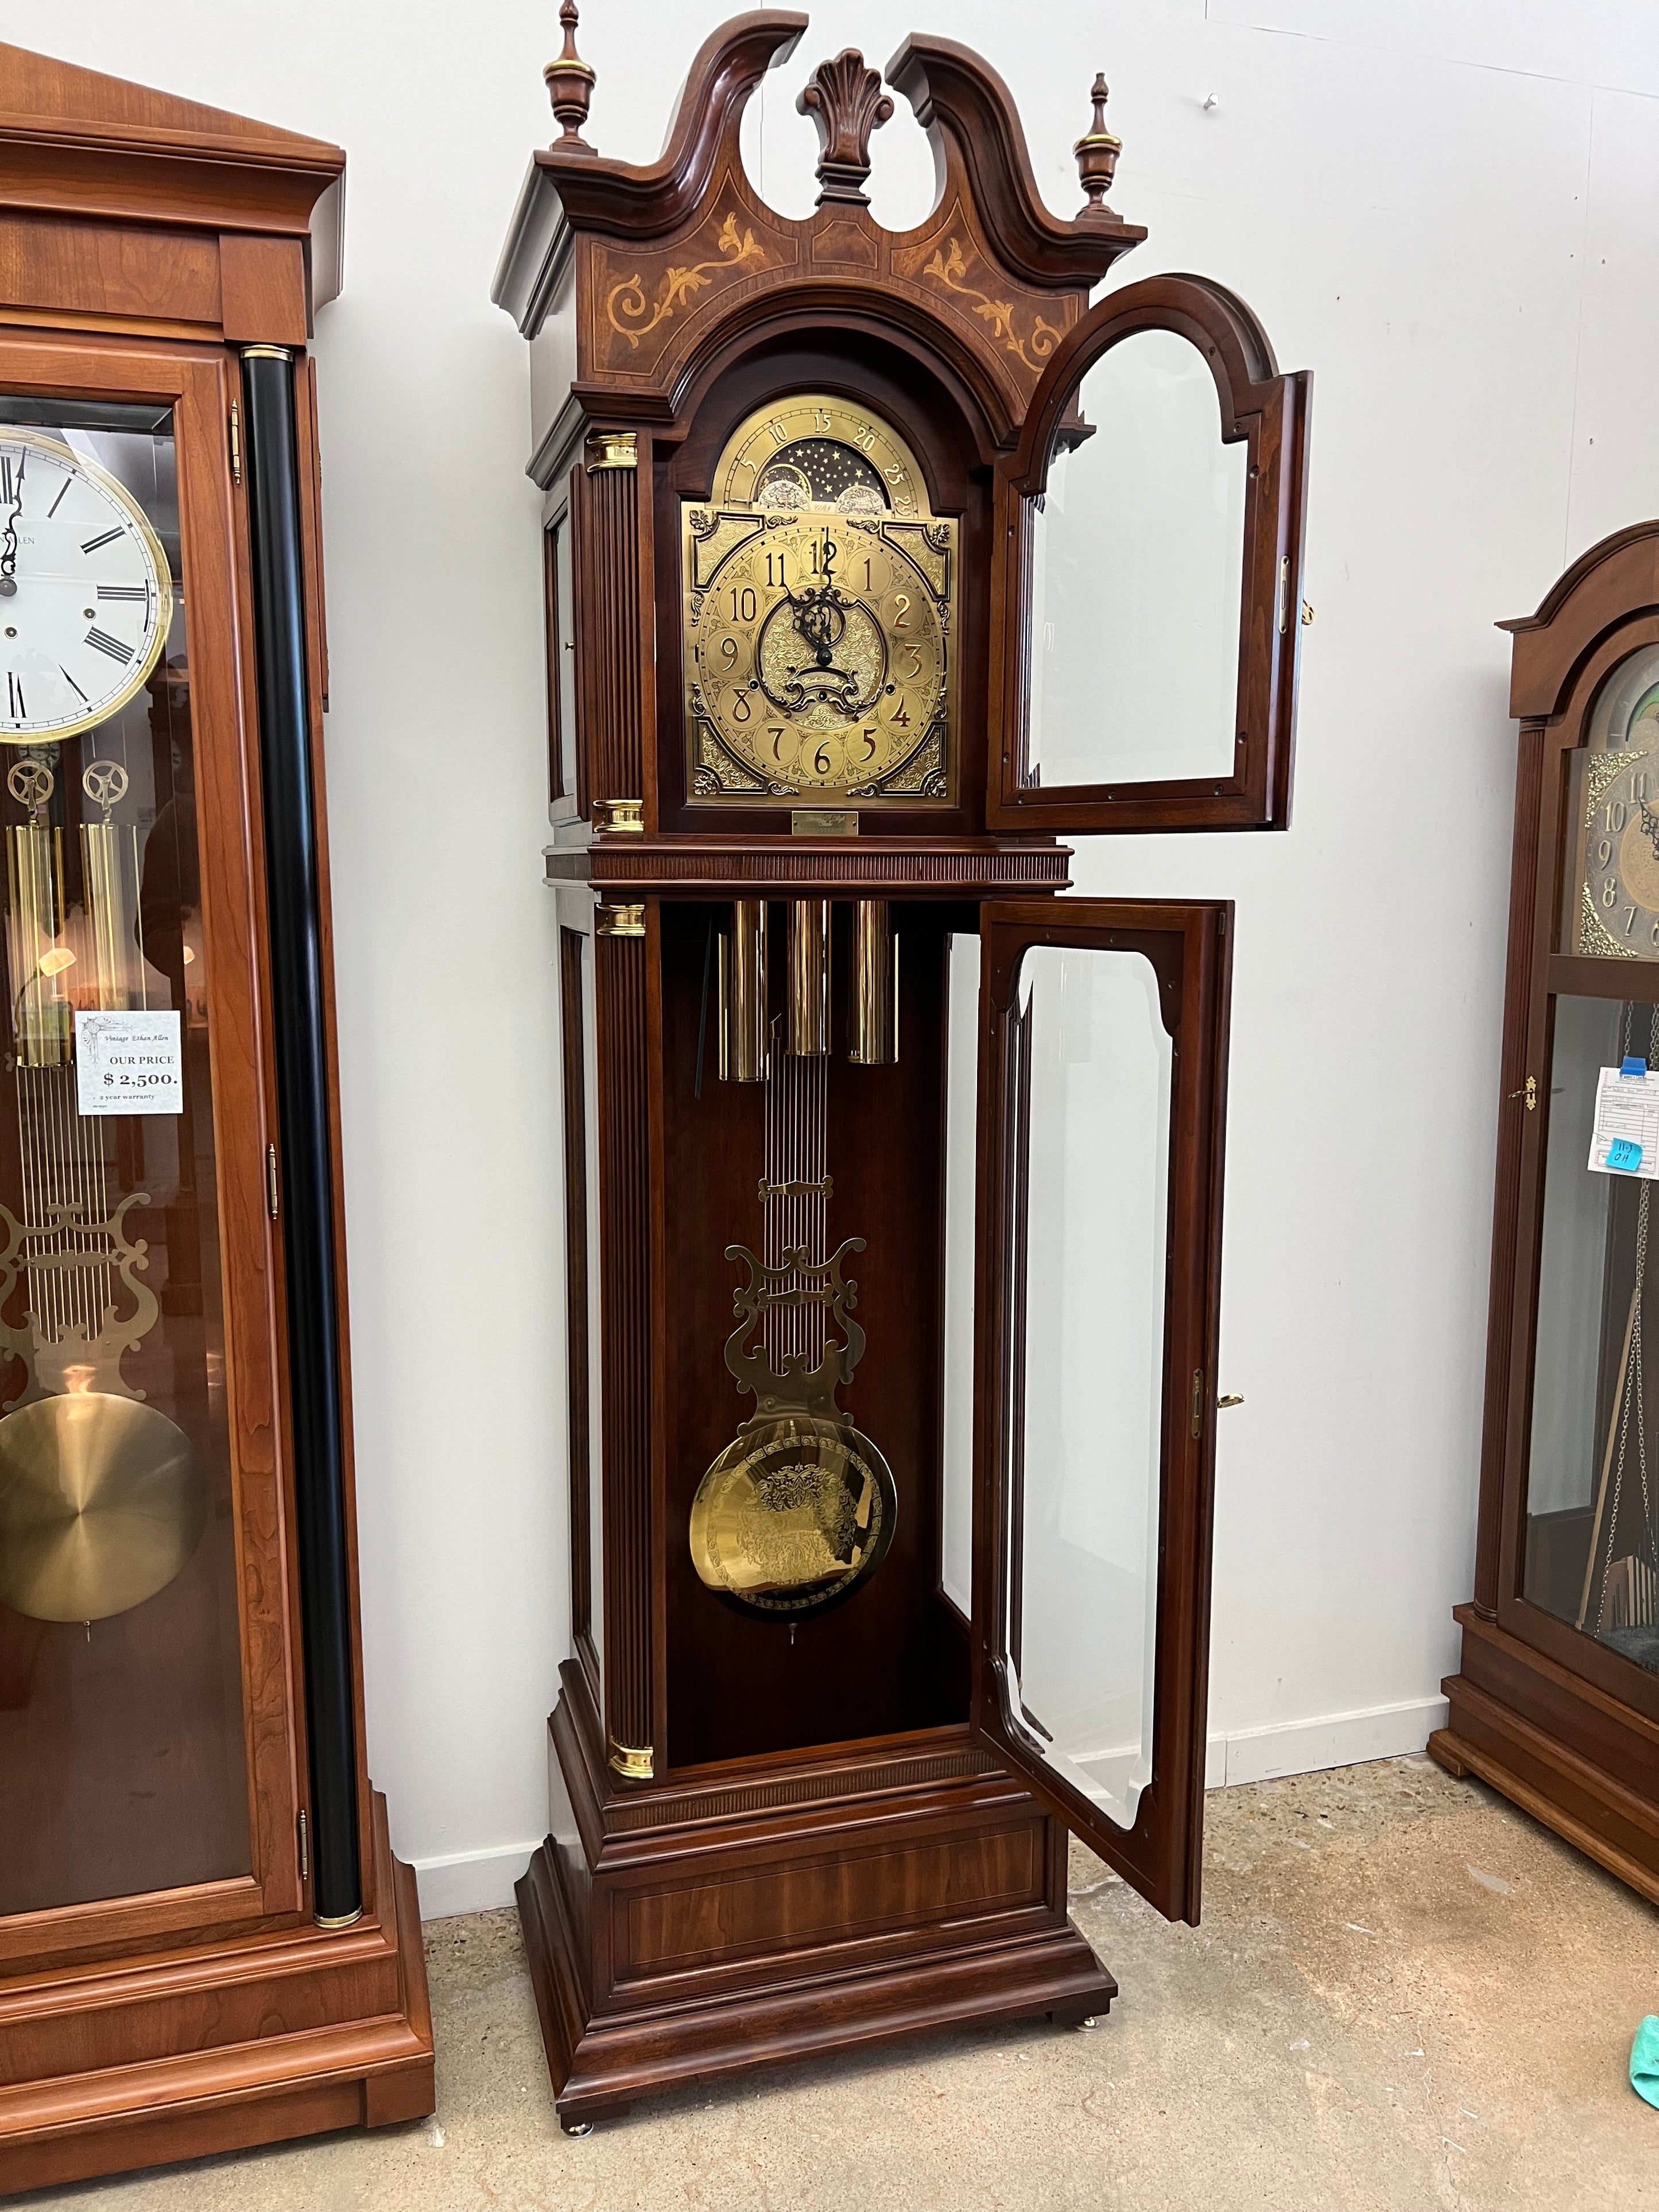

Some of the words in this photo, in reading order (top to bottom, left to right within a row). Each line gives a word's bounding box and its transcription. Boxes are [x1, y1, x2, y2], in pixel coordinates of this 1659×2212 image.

[769, 423, 788, 446] 10
[814, 413, 832, 433] 15
[852, 427, 875, 452] 20
[740, 456, 757, 474] 5
[883, 463, 905, 486] 25
[765, 552, 786, 587] 11
[809, 539, 838, 575] 12
[863, 556, 873, 591] 1
[730, 586, 757, 622] 10
[894, 594, 911, 628] 2
[720, 637, 739, 671] 9
[904, 644, 922, 679] 3
[732, 687, 751, 722] 8
[889, 693, 910, 727] 4
[767, 727, 786, 761] 7
[813, 740, 831, 775] 6
[859, 727, 877, 762] 5
[1629, 772, 1647, 804] 11
[1604, 802, 1626, 832] 10
[1598, 839, 1612, 870] 9
[1603, 877, 1617, 908] 8
[1623, 907, 1637, 937] 7
[103, 1072, 114, 1087] $
[120, 1074, 177, 1087] 2,500.
